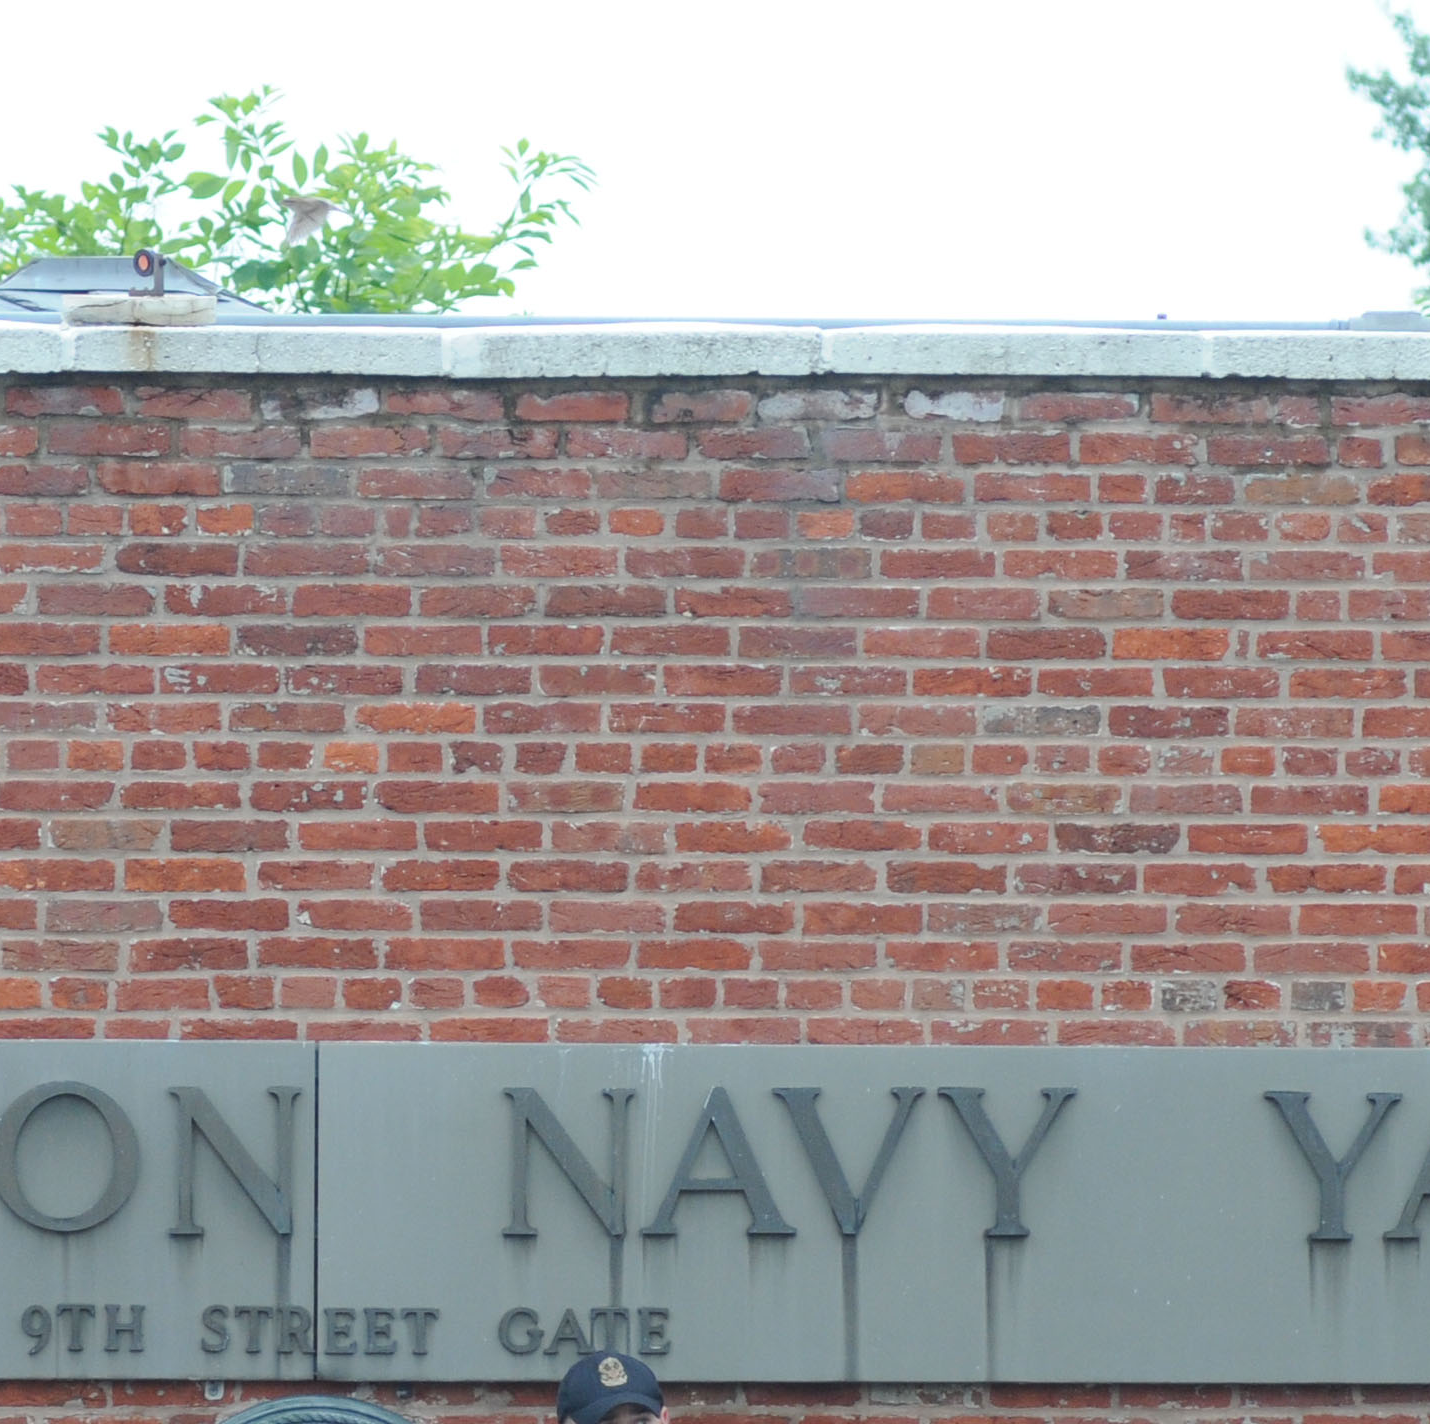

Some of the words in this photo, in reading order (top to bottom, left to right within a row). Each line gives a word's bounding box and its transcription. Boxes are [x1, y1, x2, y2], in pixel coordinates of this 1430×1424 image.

[502, 1086, 1077, 1238] NAVY
[21, 1303, 146, 1355] 9TH
[200, 1304, 440, 1356] STREET
[497, 1306, 671, 1356] GATE
